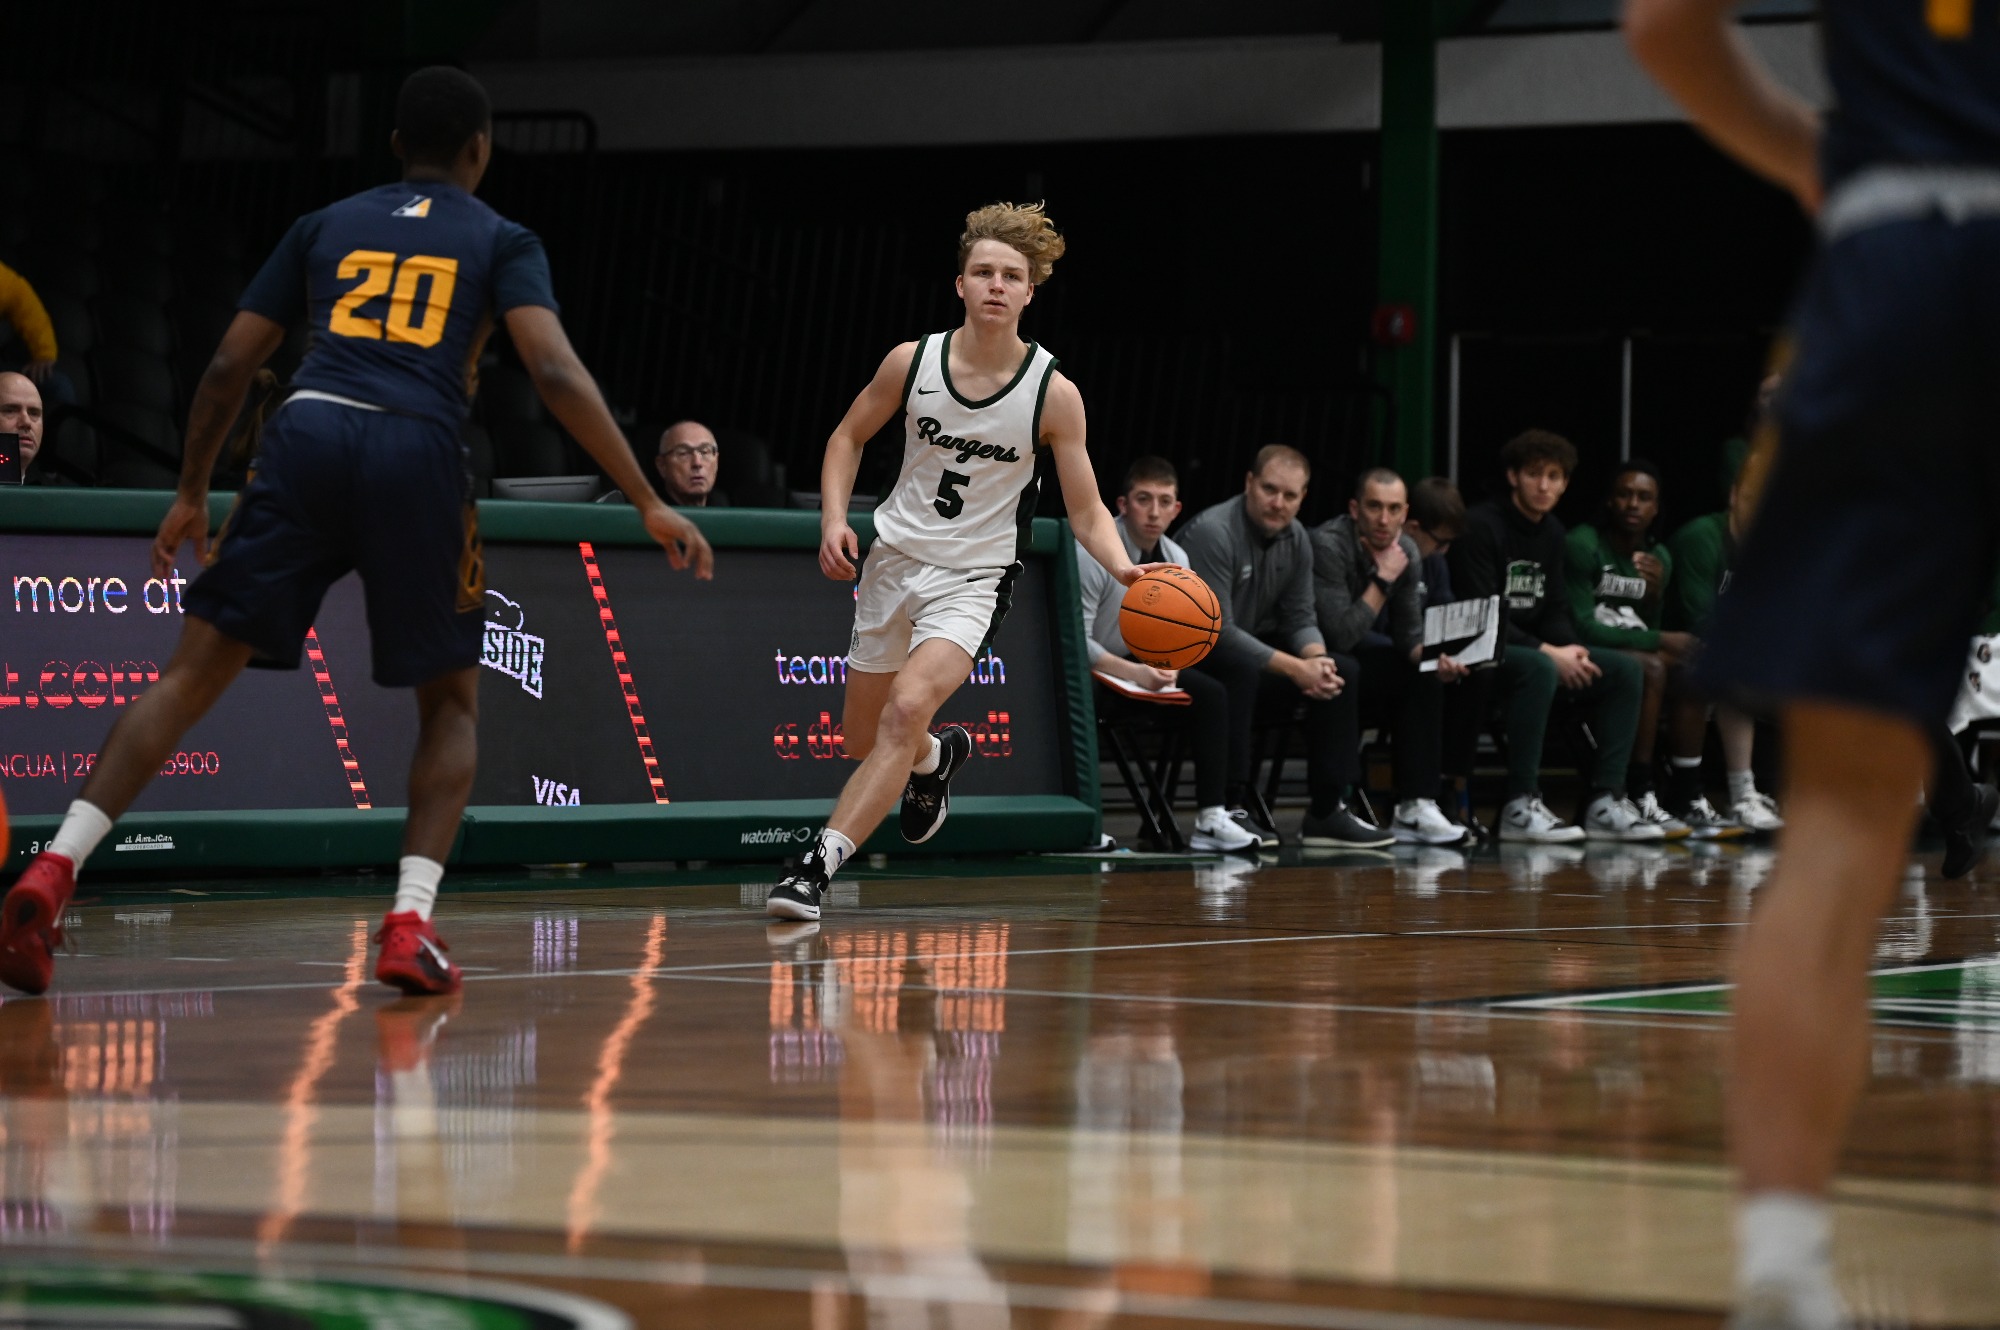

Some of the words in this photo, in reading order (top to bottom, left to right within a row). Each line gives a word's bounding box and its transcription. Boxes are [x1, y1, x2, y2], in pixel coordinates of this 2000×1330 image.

[328, 249, 459, 349] 20
[916, 416, 1020, 464] Rangers
[933, 468, 971, 520] 5
[13, 575, 129, 613] more
[143, 569, 187, 614] at
[481, 622, 545, 699] SIDE
[531, 774, 581, 807] VISA
[740, 827, 792, 844] watchfire
